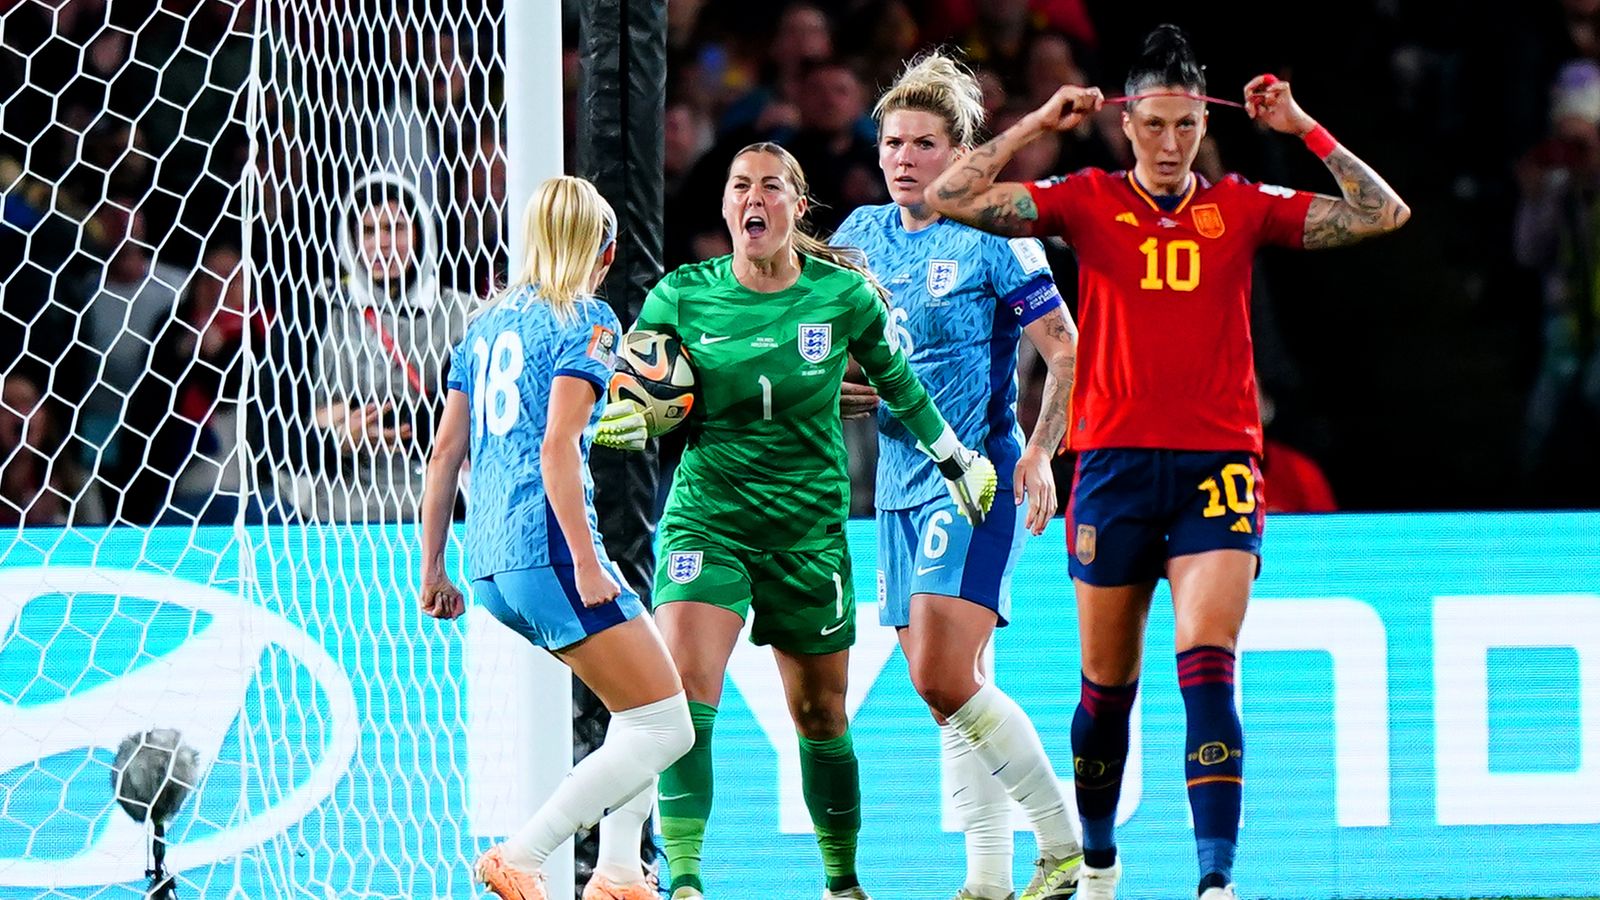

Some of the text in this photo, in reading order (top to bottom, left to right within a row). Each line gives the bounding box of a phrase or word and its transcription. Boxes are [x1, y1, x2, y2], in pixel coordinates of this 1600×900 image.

[1138, 237, 1200, 292] 10
[472, 330, 524, 439] 18
[757, 374, 772, 421] 1
[1197, 463, 1256, 518] 10
[923, 509, 953, 559] 6
[832, 571, 843, 619] 1
